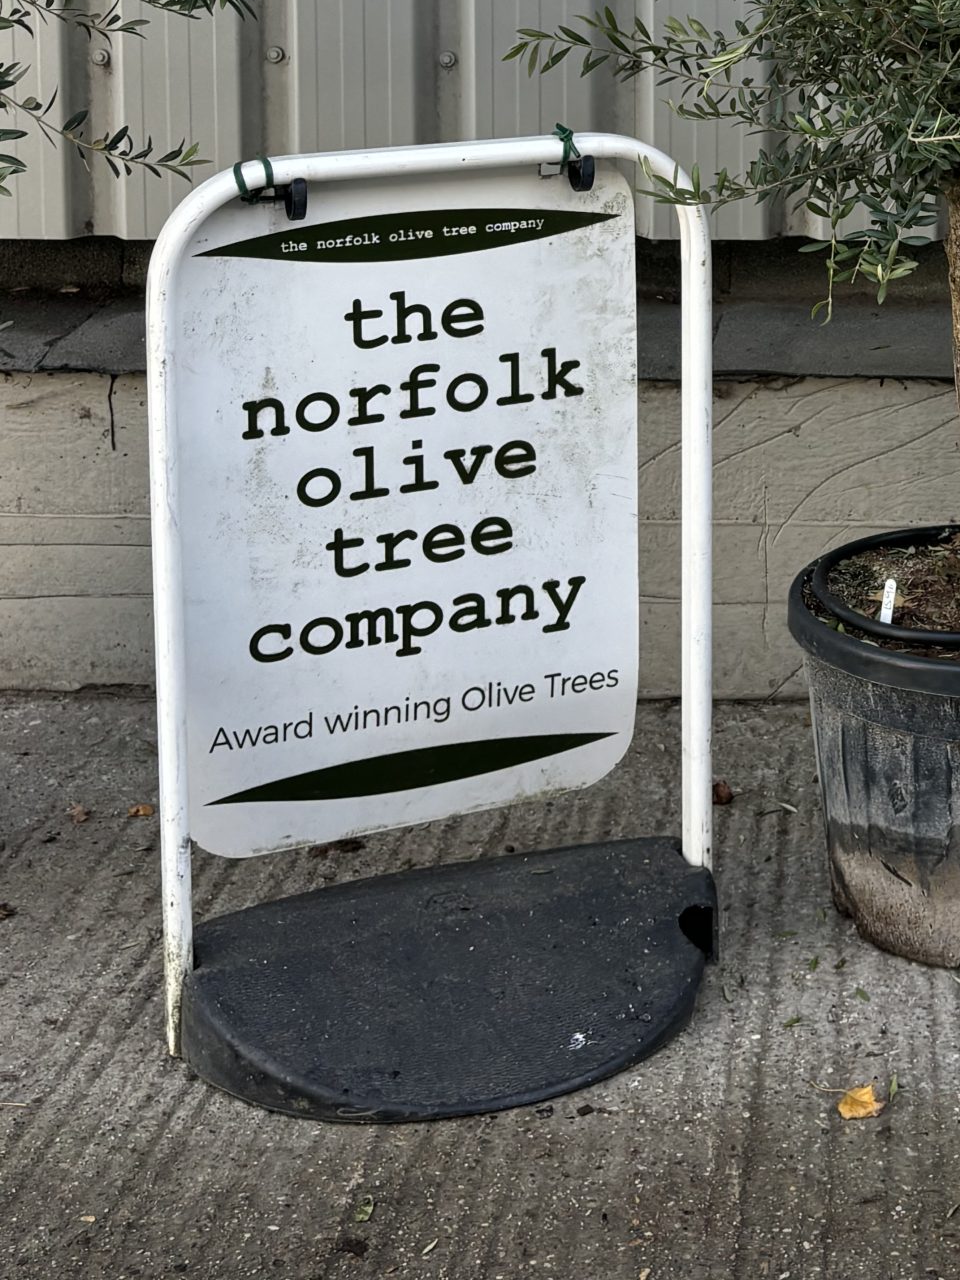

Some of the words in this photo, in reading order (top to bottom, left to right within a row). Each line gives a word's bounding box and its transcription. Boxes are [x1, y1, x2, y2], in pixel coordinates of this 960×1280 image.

[280, 240, 308, 253] the
[316, 232, 381, 249] norfolk
[388, 229, 434, 242] olive
[442, 224, 477, 237] tree
[485, 218, 545, 233] company
[344, 290, 484, 350] the
[241, 347, 585, 440] norfolk
[296, 439, 537, 508] olive
[325, 516, 513, 578] tree
[249, 575, 586, 663] company
[208, 712, 313, 754] Award
[324, 696, 451, 734] winning
[461, 682, 536, 712] Olive
[544, 668, 619, 699] Trees
